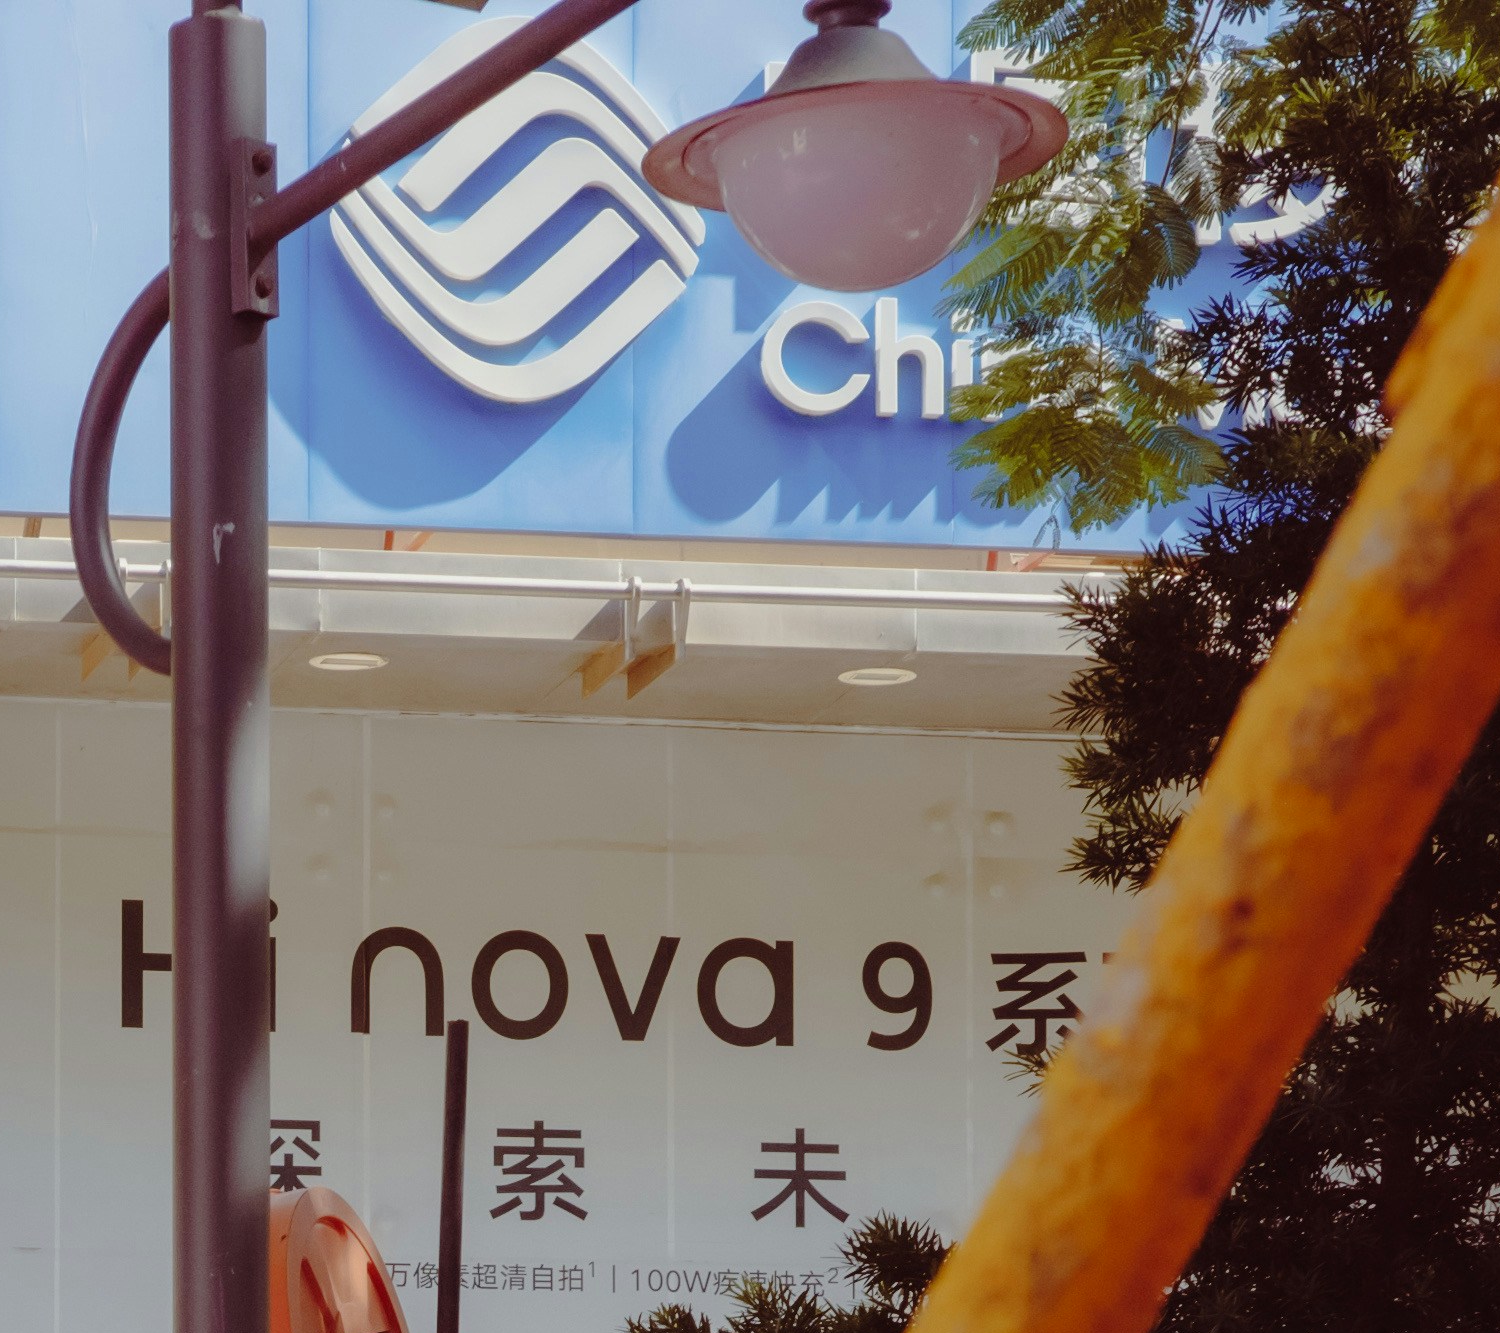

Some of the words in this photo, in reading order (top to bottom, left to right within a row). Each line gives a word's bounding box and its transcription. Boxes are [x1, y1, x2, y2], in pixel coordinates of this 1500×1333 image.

[761, 297, 1120, 422] Chi
[350, 926, 795, 1047] nova
[861, 940, 933, 1052] 9
[985, 952, 1117, 1056] 系
